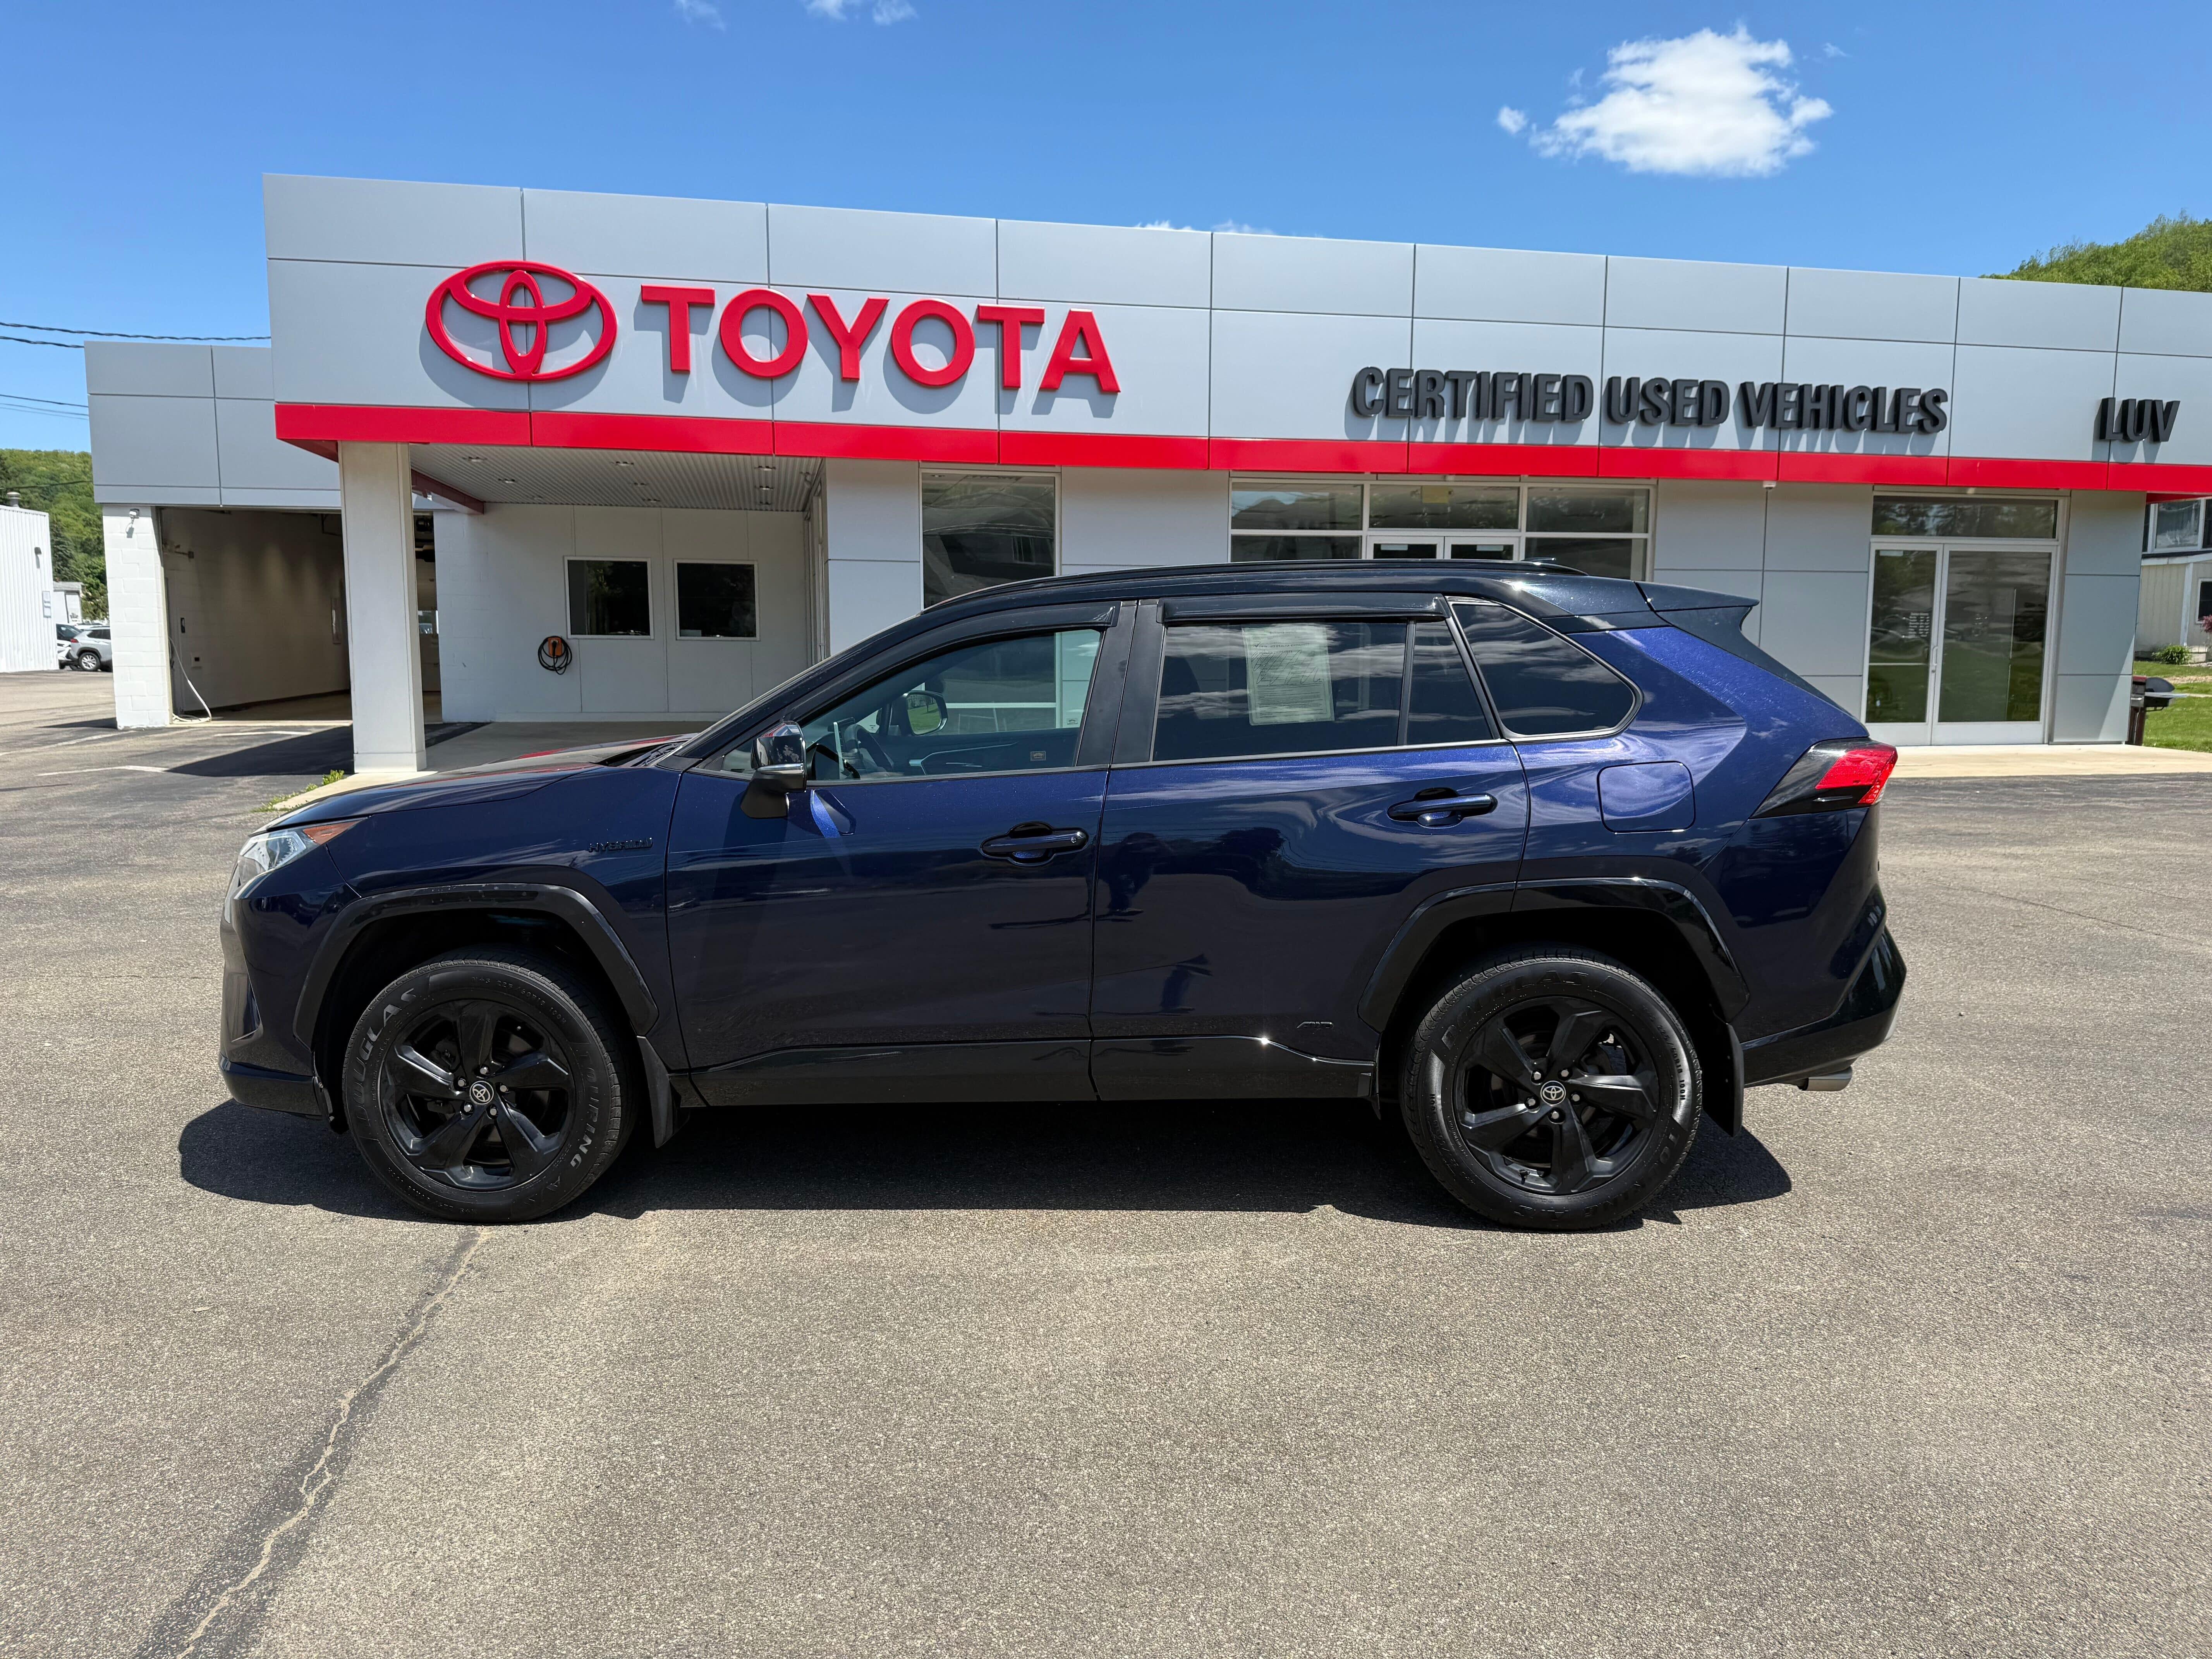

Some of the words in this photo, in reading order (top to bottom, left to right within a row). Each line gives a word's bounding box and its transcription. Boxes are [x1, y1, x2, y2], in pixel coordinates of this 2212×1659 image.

[641, 284, 1121, 393] TOYOTA
[1353, 367, 1594, 422] CERTIFIED
[1607, 376, 1730, 425] USED
[1743, 382, 1948, 433] VEHICLES
[2099, 397, 2181, 442] LUV
[588, 837, 654, 853] HYBRID
[352, 988, 417, 1127] DOUGLAS
[570, 1050, 599, 1169] TOURING
